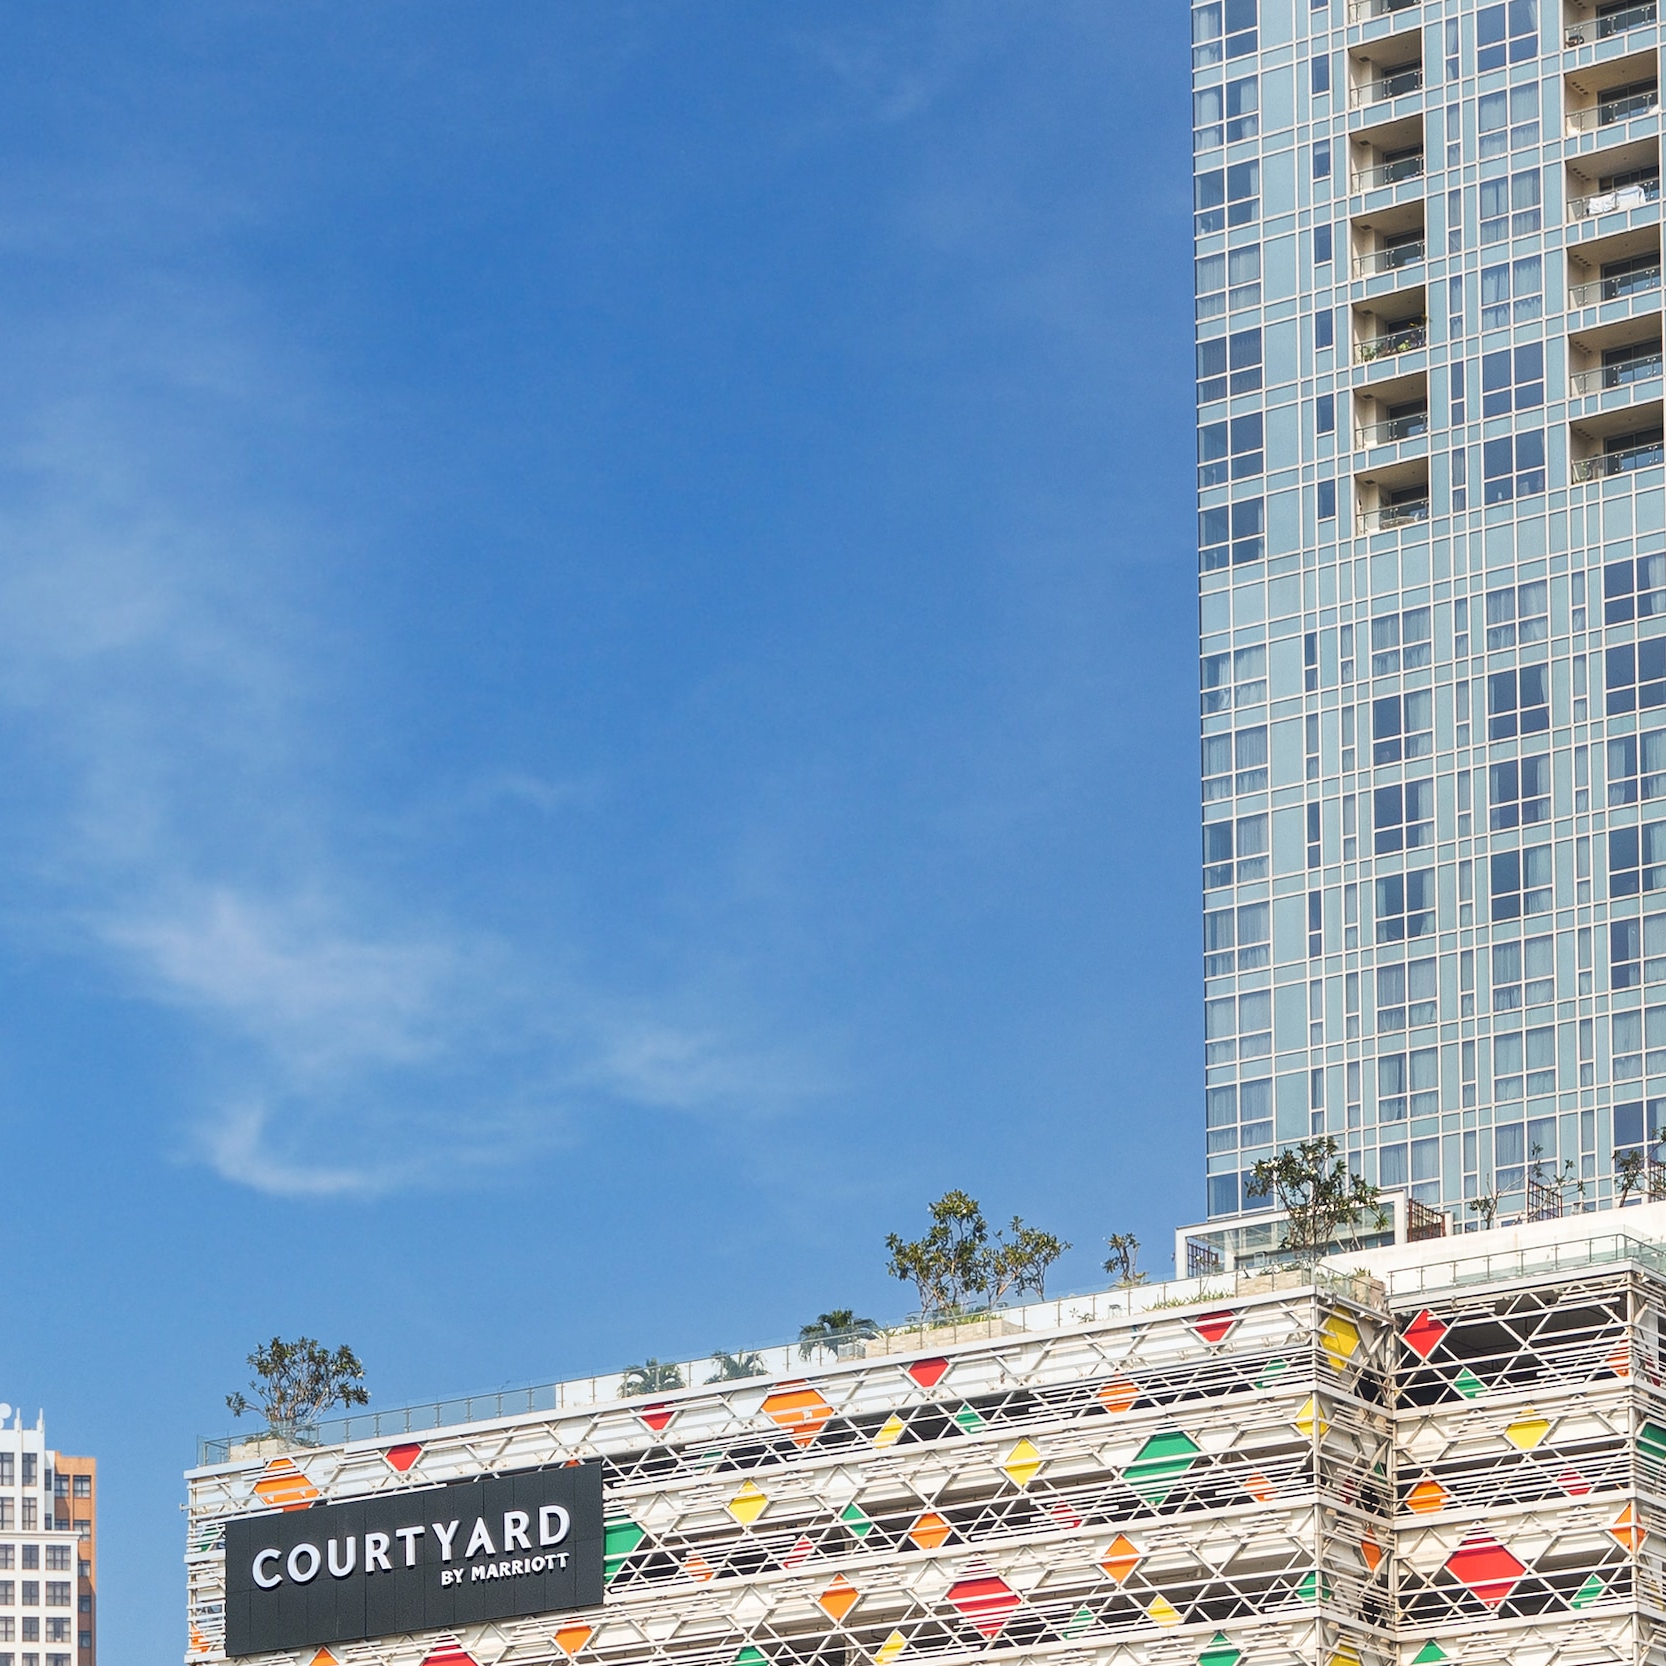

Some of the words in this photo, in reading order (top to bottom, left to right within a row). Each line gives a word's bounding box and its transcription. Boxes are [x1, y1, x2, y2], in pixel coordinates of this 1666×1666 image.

[252, 1504, 571, 1588] COURTYARD
[441, 1567, 464, 1586] BY
[471, 1551, 570, 1582] MARRIOTT
